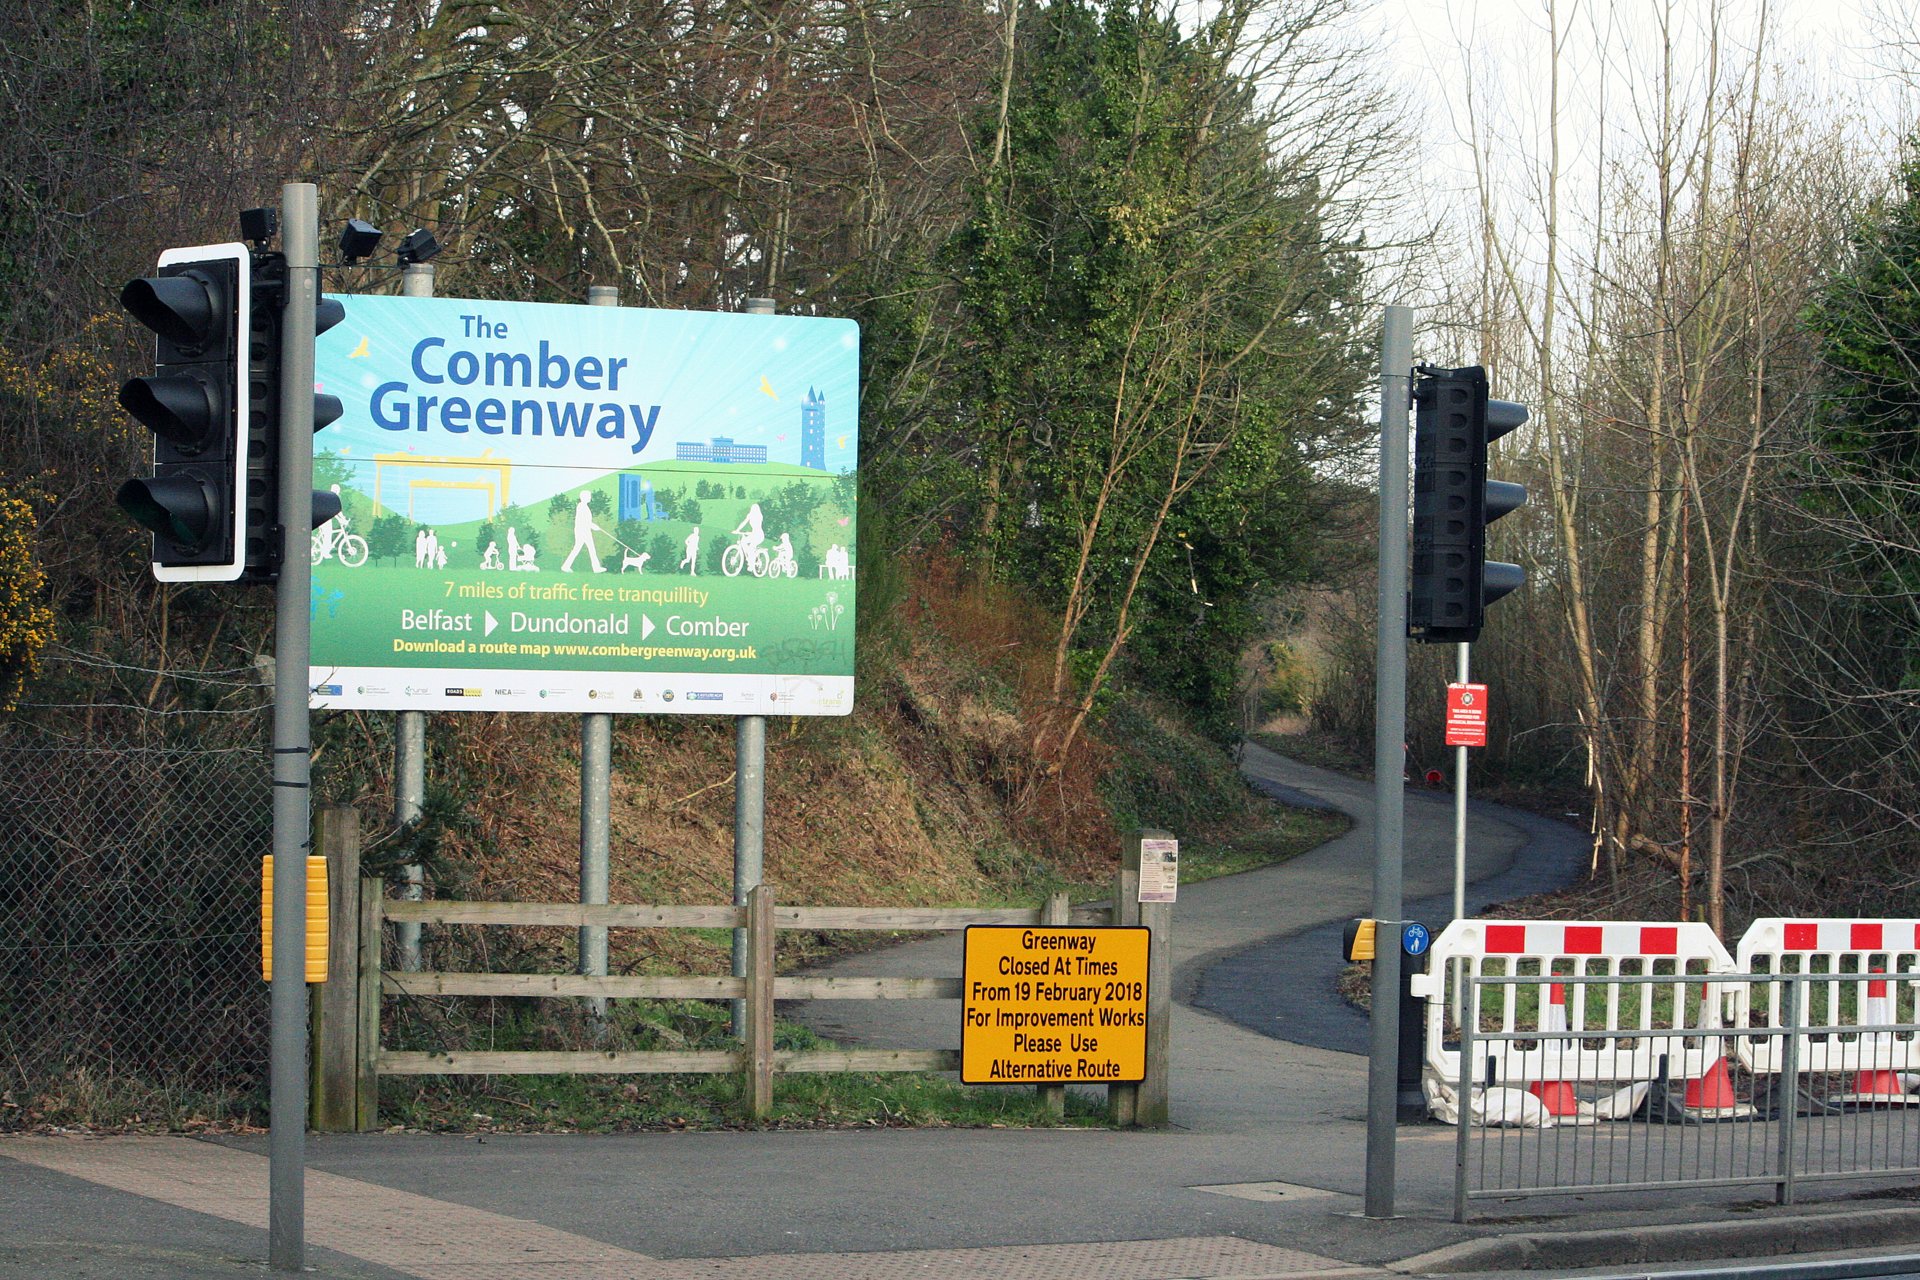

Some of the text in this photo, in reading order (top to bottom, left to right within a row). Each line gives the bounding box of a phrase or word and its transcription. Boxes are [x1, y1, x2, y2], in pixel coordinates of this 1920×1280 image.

[460, 315, 507, 338] The
[412, 337, 627, 390] Comber
[370, 382, 660, 453] Greenway
[445, 581, 708, 607] 7 miles of traffic free tranquillity
[403, 609, 749, 636] Belfast Dundonald Comber
[394, 639, 756, 661] Download a route map www.combergreenway.org.uk
[1023, 931, 1095, 953] Greenway
[1000, 956, 1117, 975] Closed At Times
[974, 982, 1141, 1004] From 19 February 2018
[968, 1008, 1144, 1029] For Improvement Works
[1015, 1034, 1097, 1052] Please Use
[991, 1059, 1119, 1078] Alternative Route
